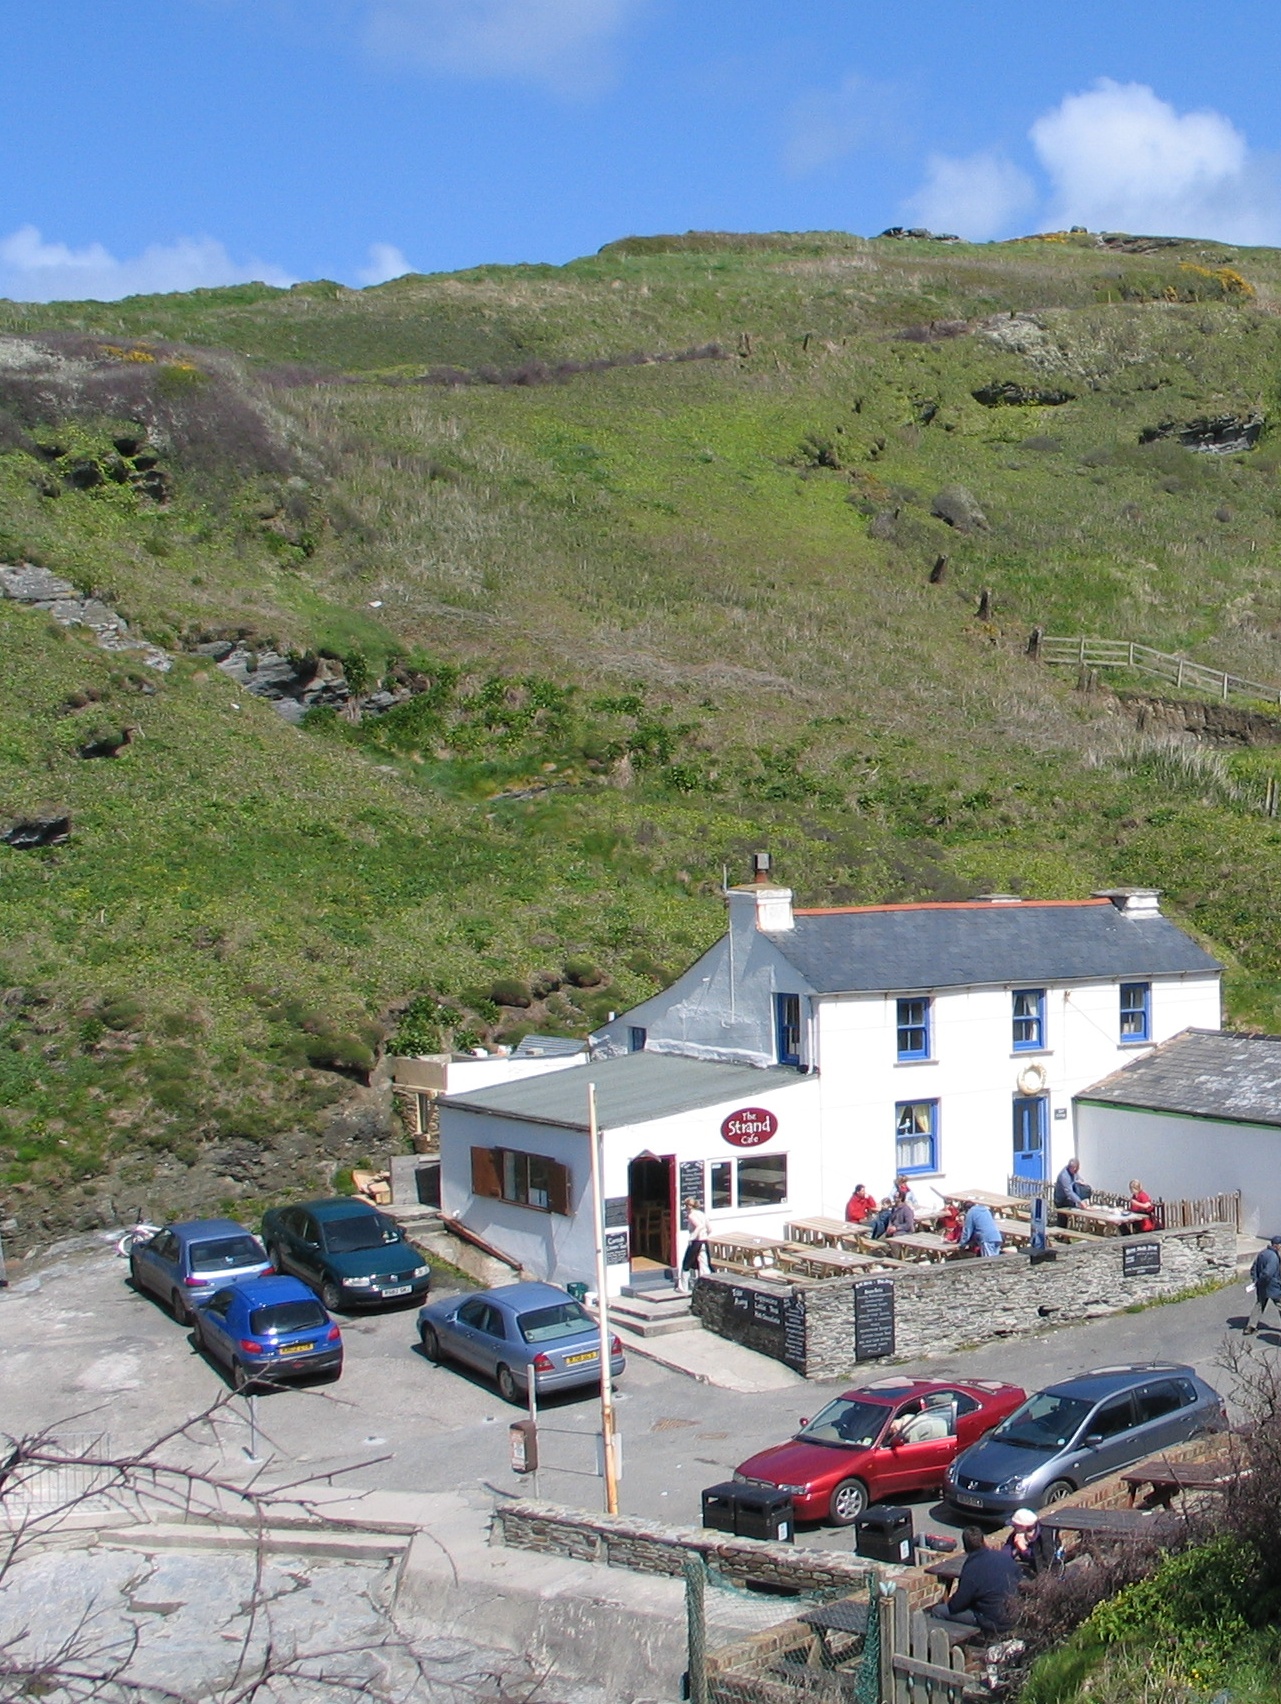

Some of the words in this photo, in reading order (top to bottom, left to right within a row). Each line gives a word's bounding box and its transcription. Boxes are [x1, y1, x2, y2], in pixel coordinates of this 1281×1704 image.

[742, 1111, 757, 1121] The
[728, 1115, 771, 1136] Strand
[740, 1133, 759, 1145] Cafe
